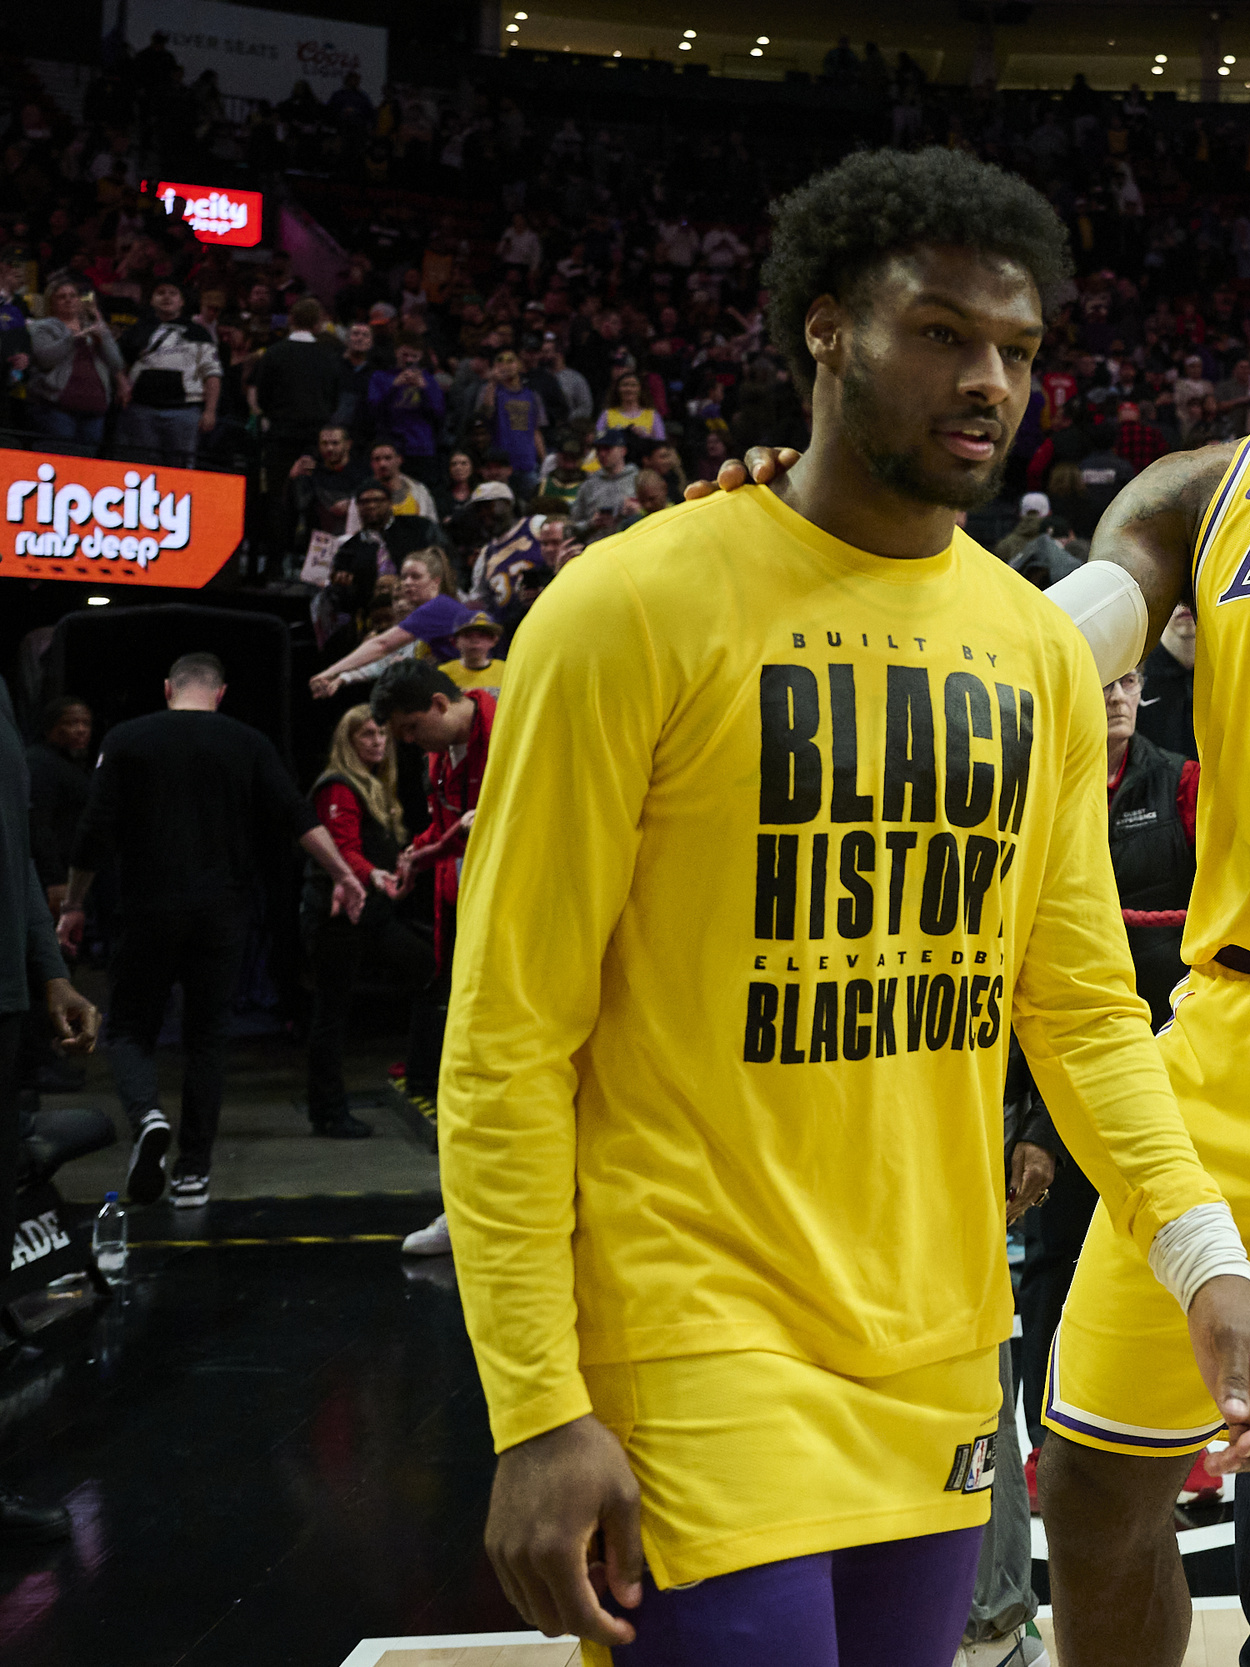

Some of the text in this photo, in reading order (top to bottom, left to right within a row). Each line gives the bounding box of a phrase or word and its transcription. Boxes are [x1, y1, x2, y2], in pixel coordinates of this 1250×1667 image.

[6, 462, 192, 551] ripcity
[15, 526, 160, 571] runs deep
[792, 631, 998, 668] BUILT BY
[759, 663, 1035, 836] BLACK
[754, 949, 1003, 972] ELEVATED B
[743, 973, 1004, 1065] BLACK VOIES
